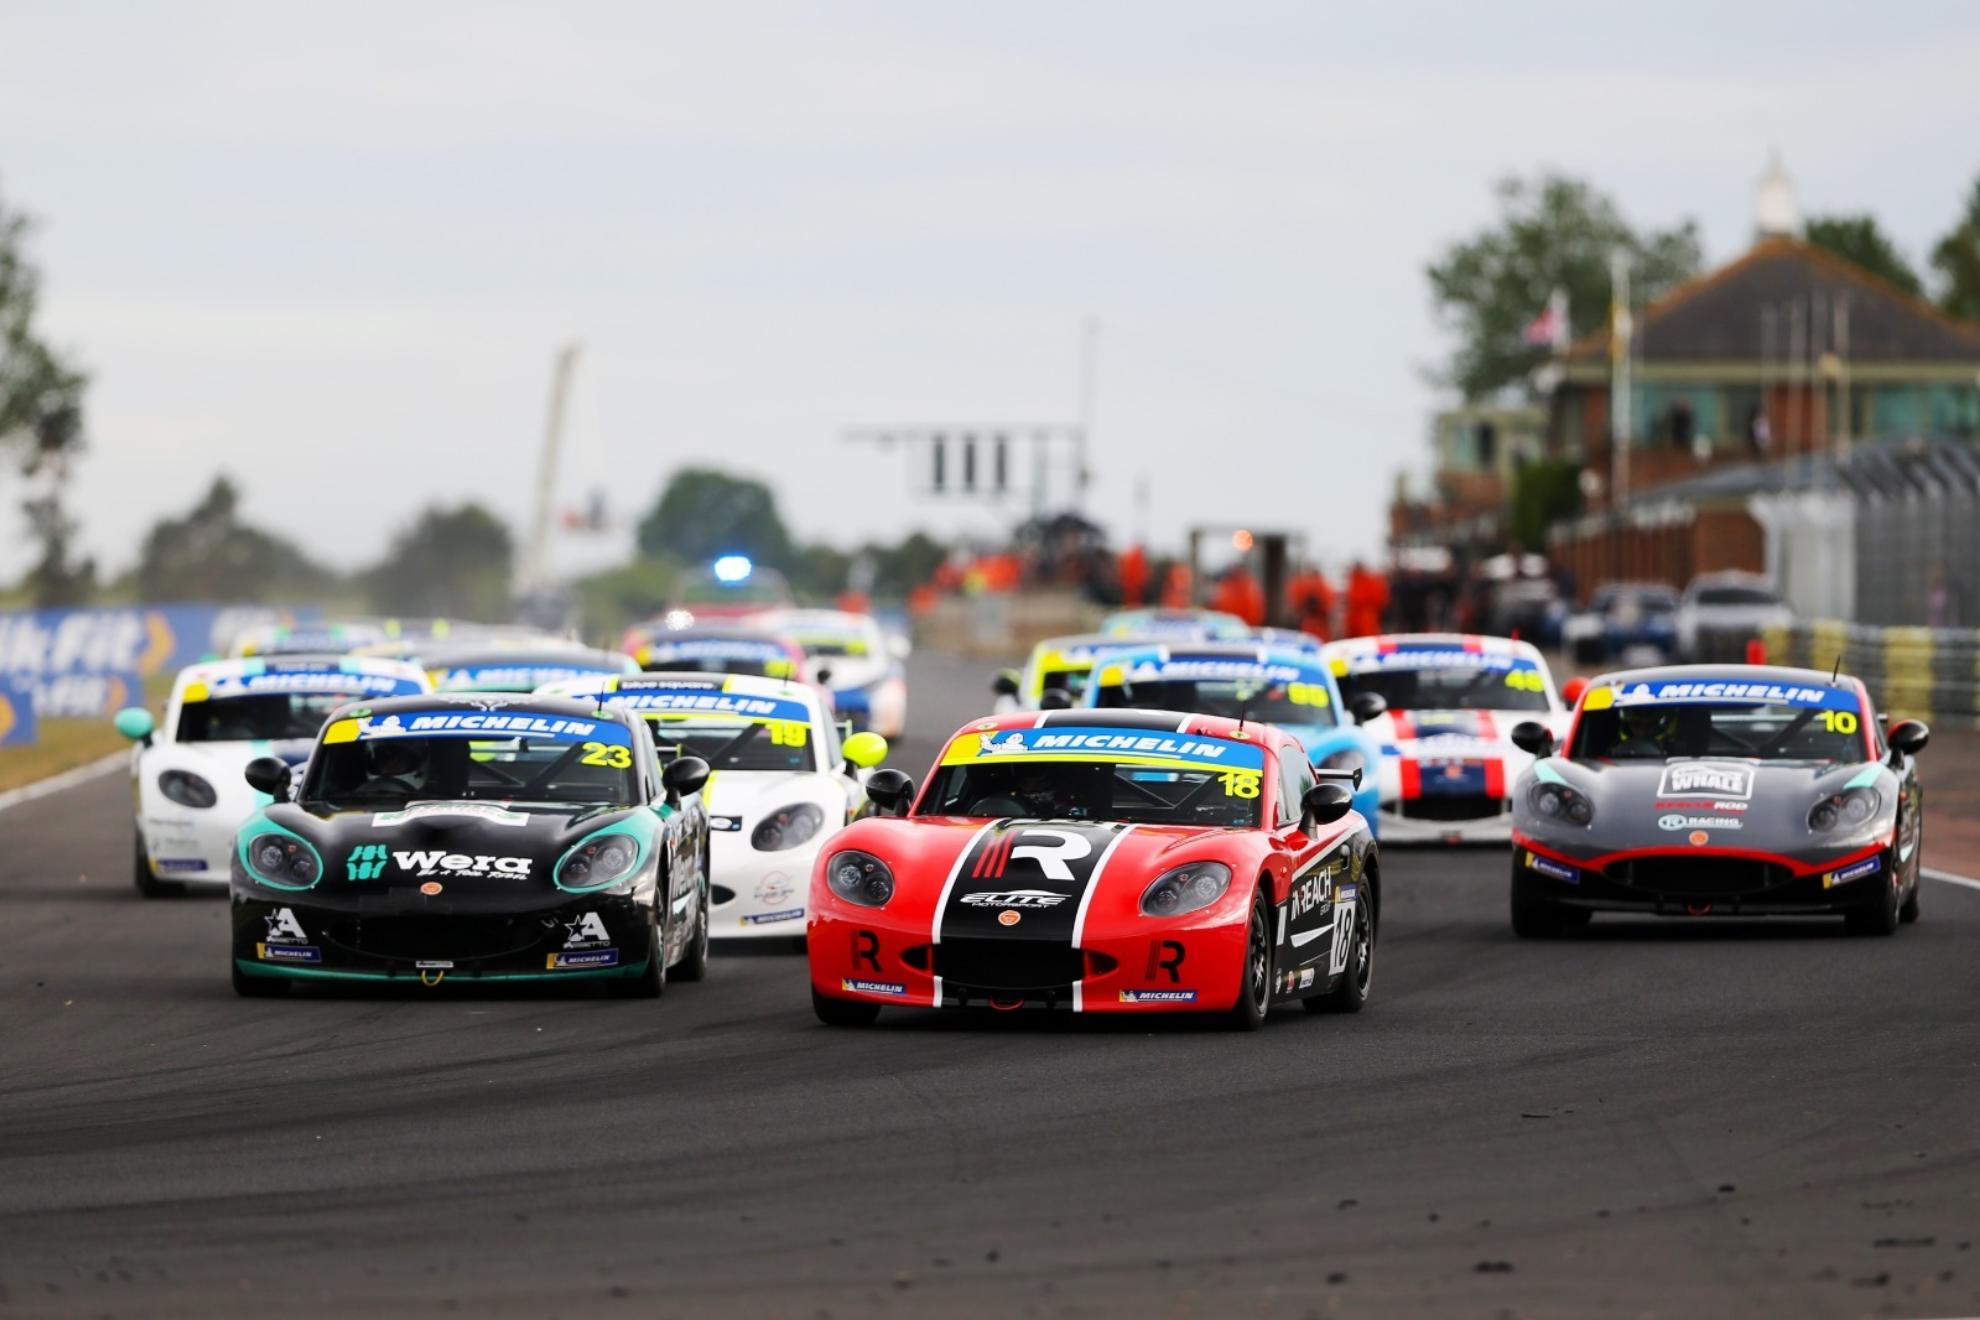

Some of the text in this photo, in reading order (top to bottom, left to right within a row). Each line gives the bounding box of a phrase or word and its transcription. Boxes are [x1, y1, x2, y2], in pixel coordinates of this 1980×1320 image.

[1659, 683, 1826, 703] MICHELIN
[608, 695, 776, 714] MICHELIN
[411, 716, 596, 736] MICHELIN
[1818, 710, 1857, 734] 10
[765, 722, 807, 747] 19
[581, 742, 632, 769] 23
[1036, 735, 1227, 758] MICHELIN
[1218, 772, 1260, 799] 18
[1688, 817, 1739, 825] RACING
[392, 851, 533, 874] Wera
[960, 893, 1066, 906] ELITE
[972, 901, 1048, 909] MOTORSPORT
[1334, 907, 1352, 968] 18
[568, 954, 610, 963] MICHELIN
[856, 982, 904, 993] MICHELIN
